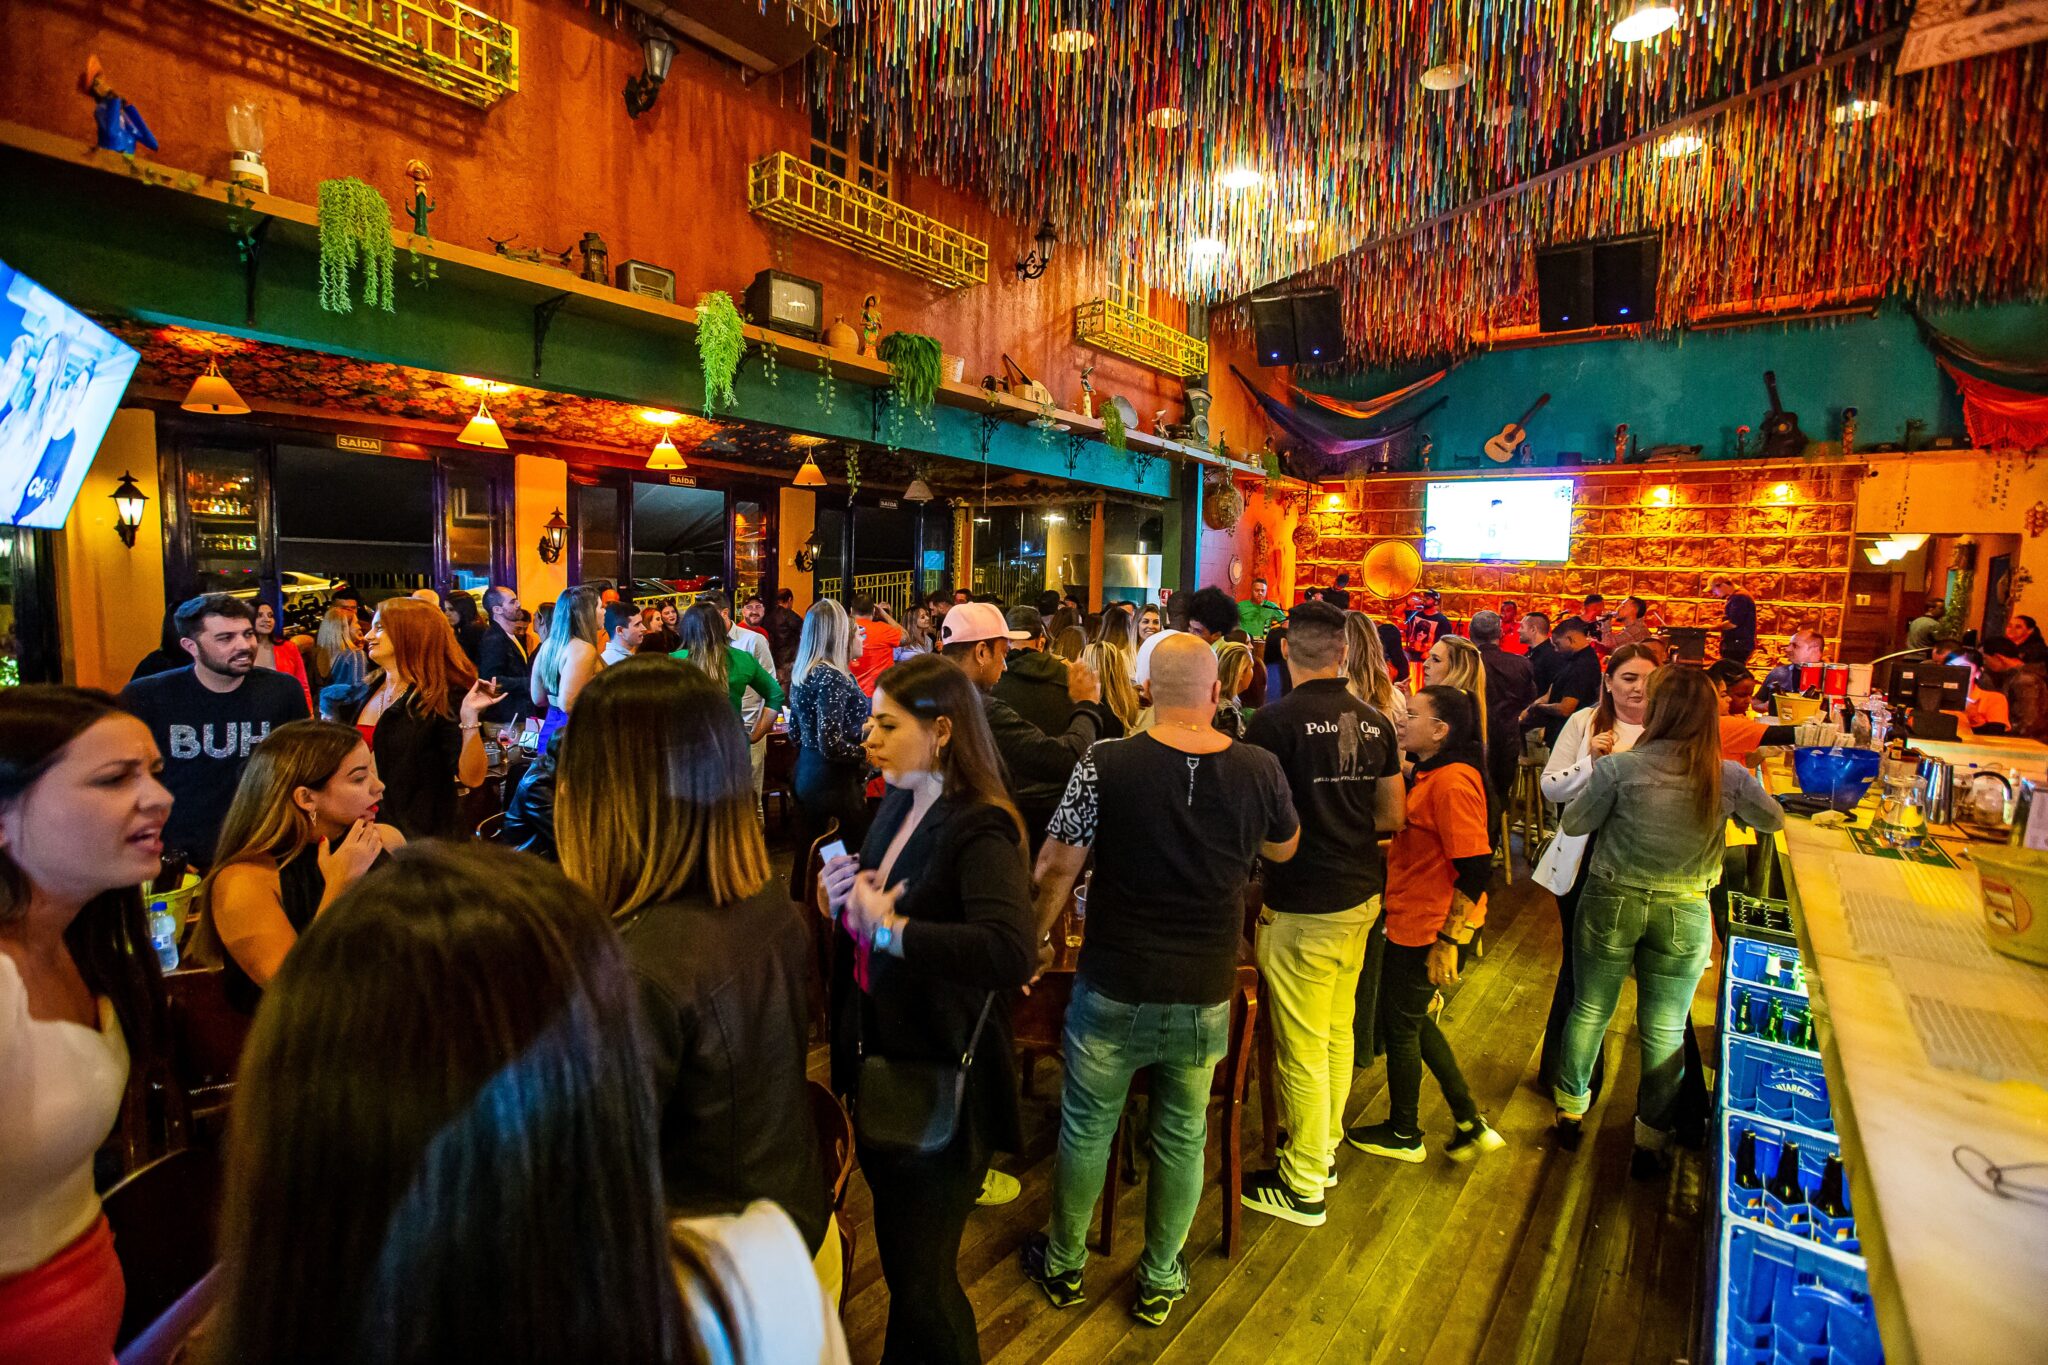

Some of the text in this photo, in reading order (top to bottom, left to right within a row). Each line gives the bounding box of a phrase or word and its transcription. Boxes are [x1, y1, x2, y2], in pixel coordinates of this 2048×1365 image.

[340, 438, 378, 450] SAÍDA
[27, 476, 48, 498] C6
[671, 476, 695, 485] SAÍDA
[1305, 721, 1381, 738] Polo Cup
